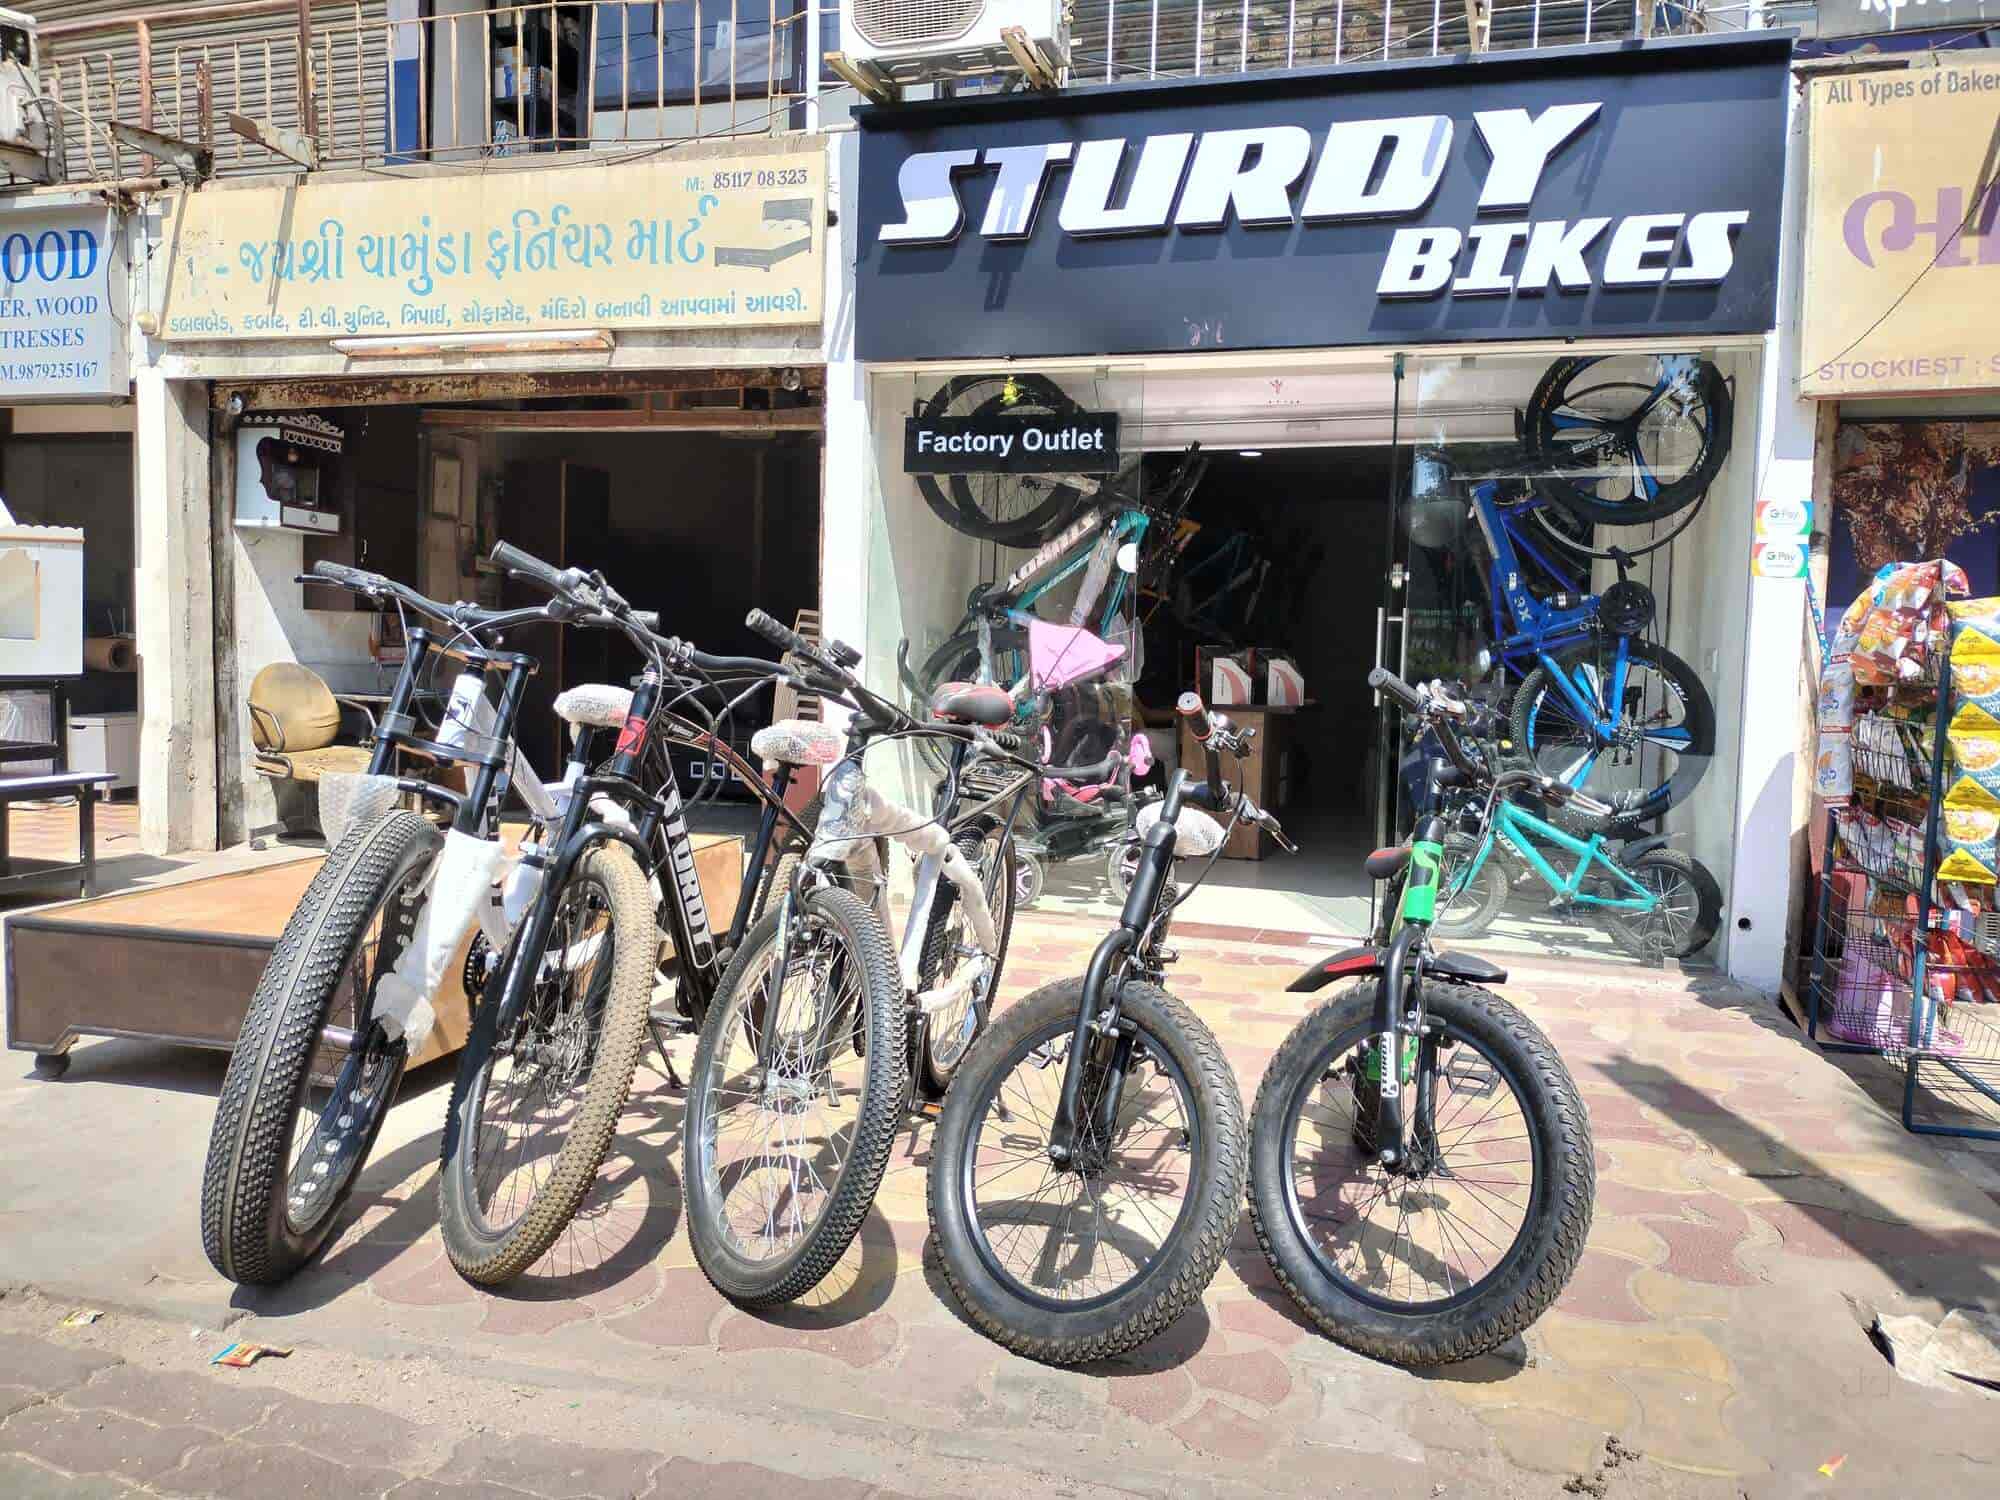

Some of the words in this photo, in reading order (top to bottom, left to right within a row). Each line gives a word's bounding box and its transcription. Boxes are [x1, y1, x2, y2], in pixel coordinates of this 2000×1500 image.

[1826, 80, 1852, 105] All
[1859, 78, 1915, 107] Types
[1920, 72, 1942, 95] of
[712, 171, 753, 190] 85117
[757, 169, 808, 186] 08323
[877, 101, 1605, 244] STURDY
[626, 194, 720, 265] માર્ટ
[1376, 210, 1751, 298] BIKES
[36, 295, 98, 317] WOOD
[1818, 356, 1966, 382] STOCKIEST
[916, 429, 1014, 458] Factory
[1021, 427, 1104, 451] Outlet
